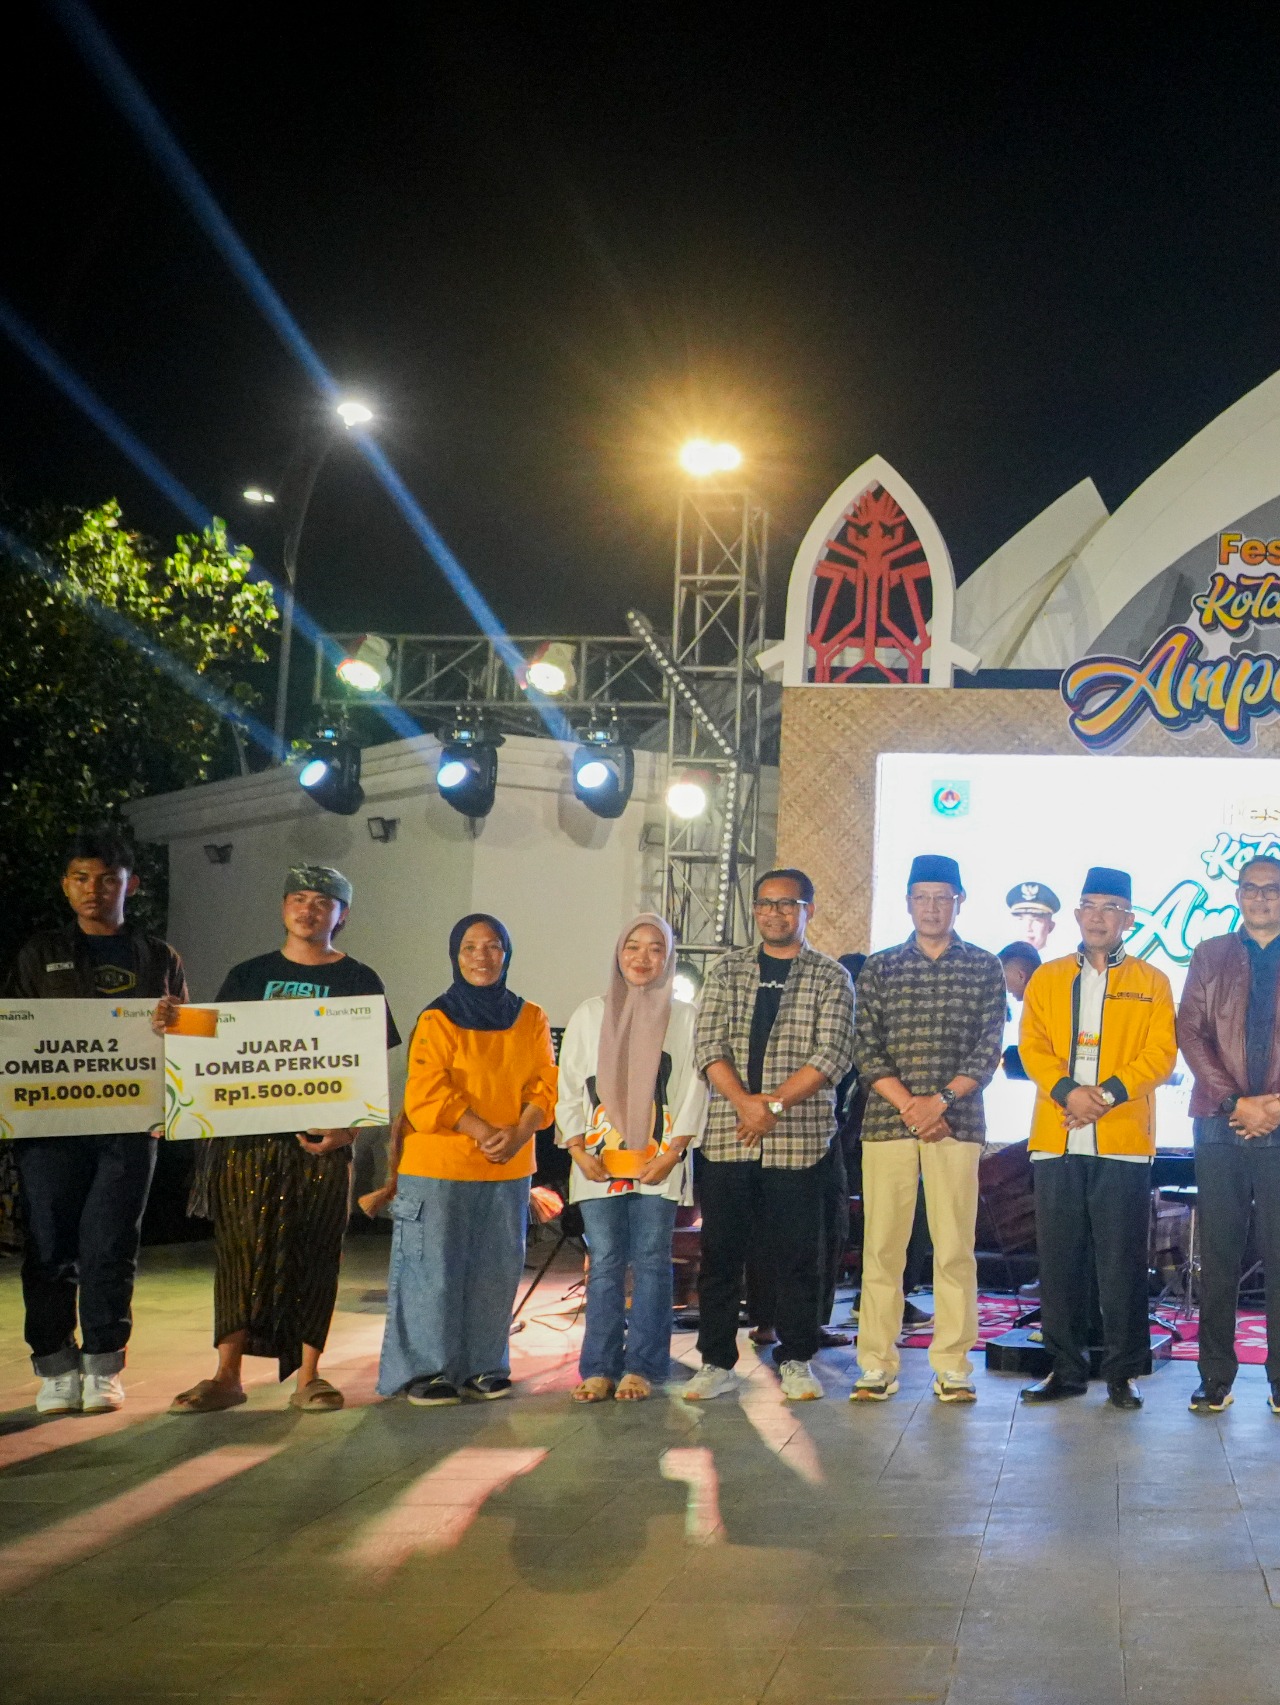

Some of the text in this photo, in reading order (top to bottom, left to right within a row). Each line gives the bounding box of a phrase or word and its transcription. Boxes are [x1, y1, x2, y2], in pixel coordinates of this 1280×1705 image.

[34, 1038, 119, 1054] JUARA 2
[237, 1037, 319, 1055] JUARA 1
[74, 1057, 156, 1073] PERKUSI
[195, 1054, 360, 1076] LOMBA PERKUSI
[14, 1083, 140, 1106] Rp1.000.000
[214, 1080, 342, 1106] Rp1.500.000
